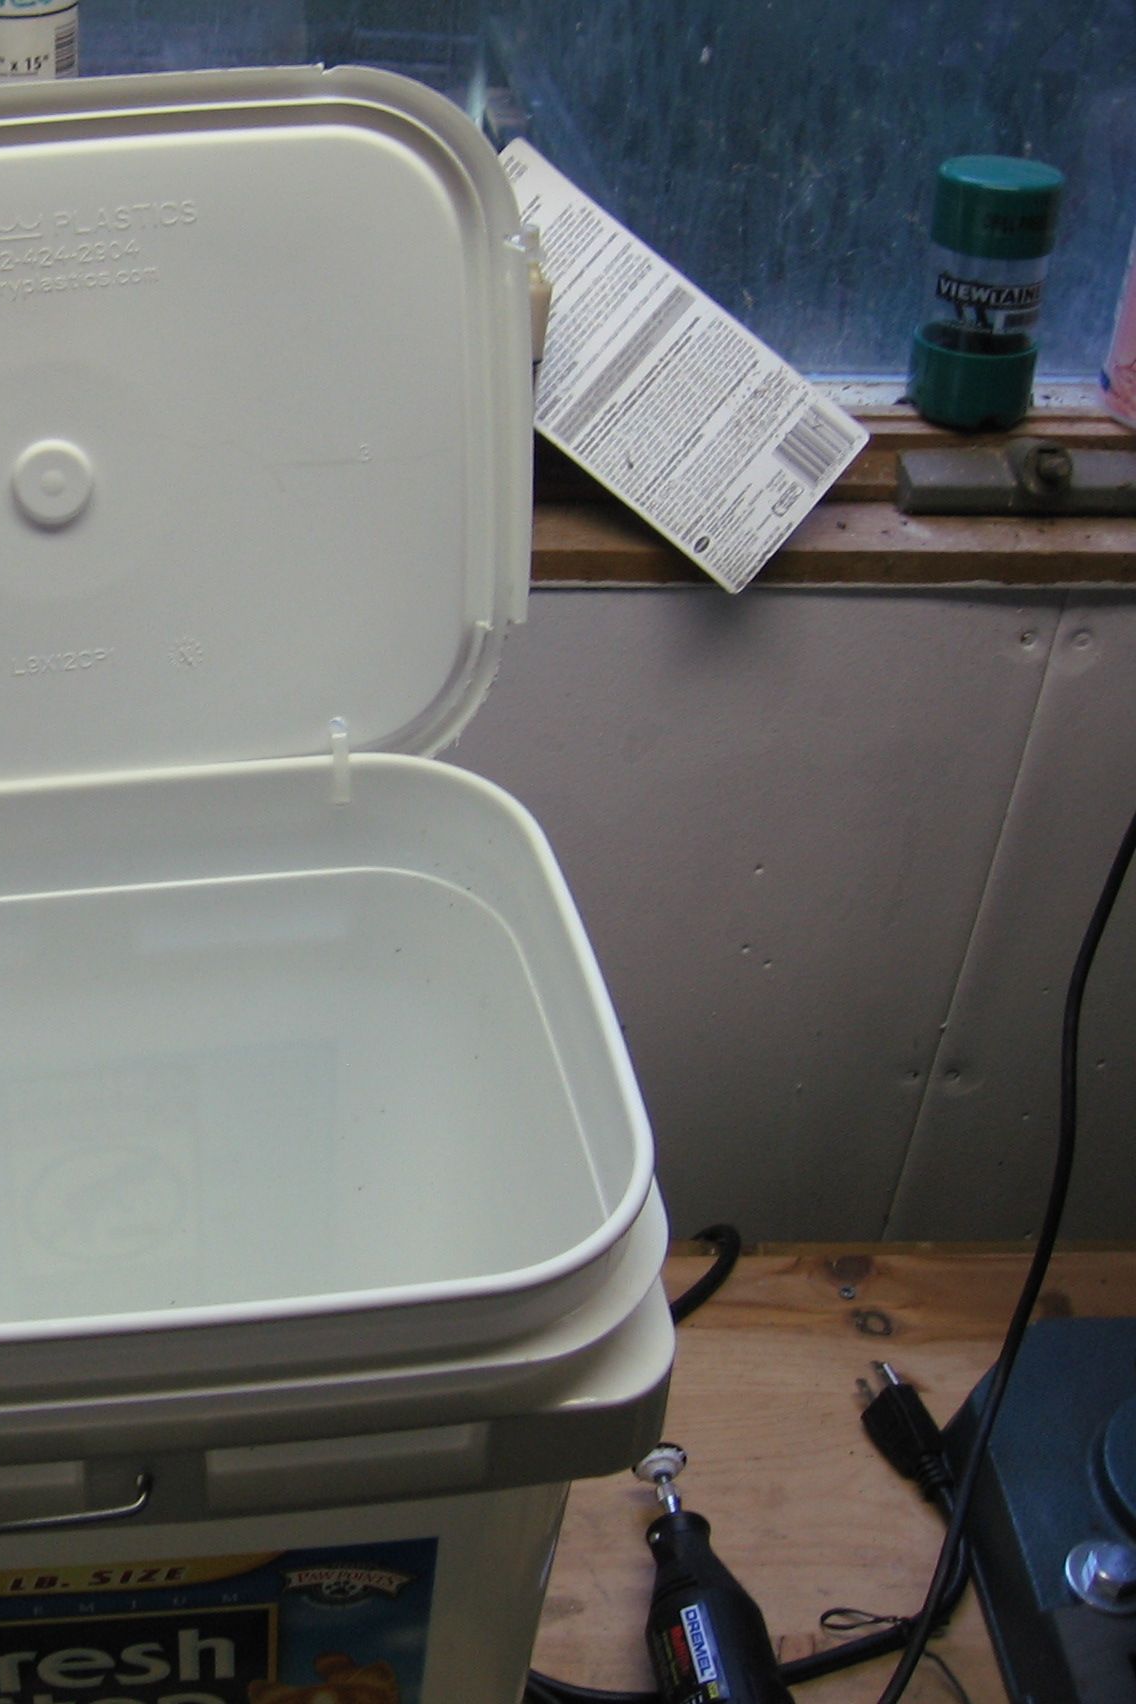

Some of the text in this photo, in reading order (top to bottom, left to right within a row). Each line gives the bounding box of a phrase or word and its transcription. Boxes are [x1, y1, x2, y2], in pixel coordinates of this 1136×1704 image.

[25, 54, 50, 71] 15"
[53, 199, 198, 237] PLASTICS
[938, 277, 1042, 305] VIEWTAINE
[8, 1574, 70, 1593] LB.
[87, 1566, 189, 1588] SIZE
[684, 1608, 712, 1677] DREMEL
